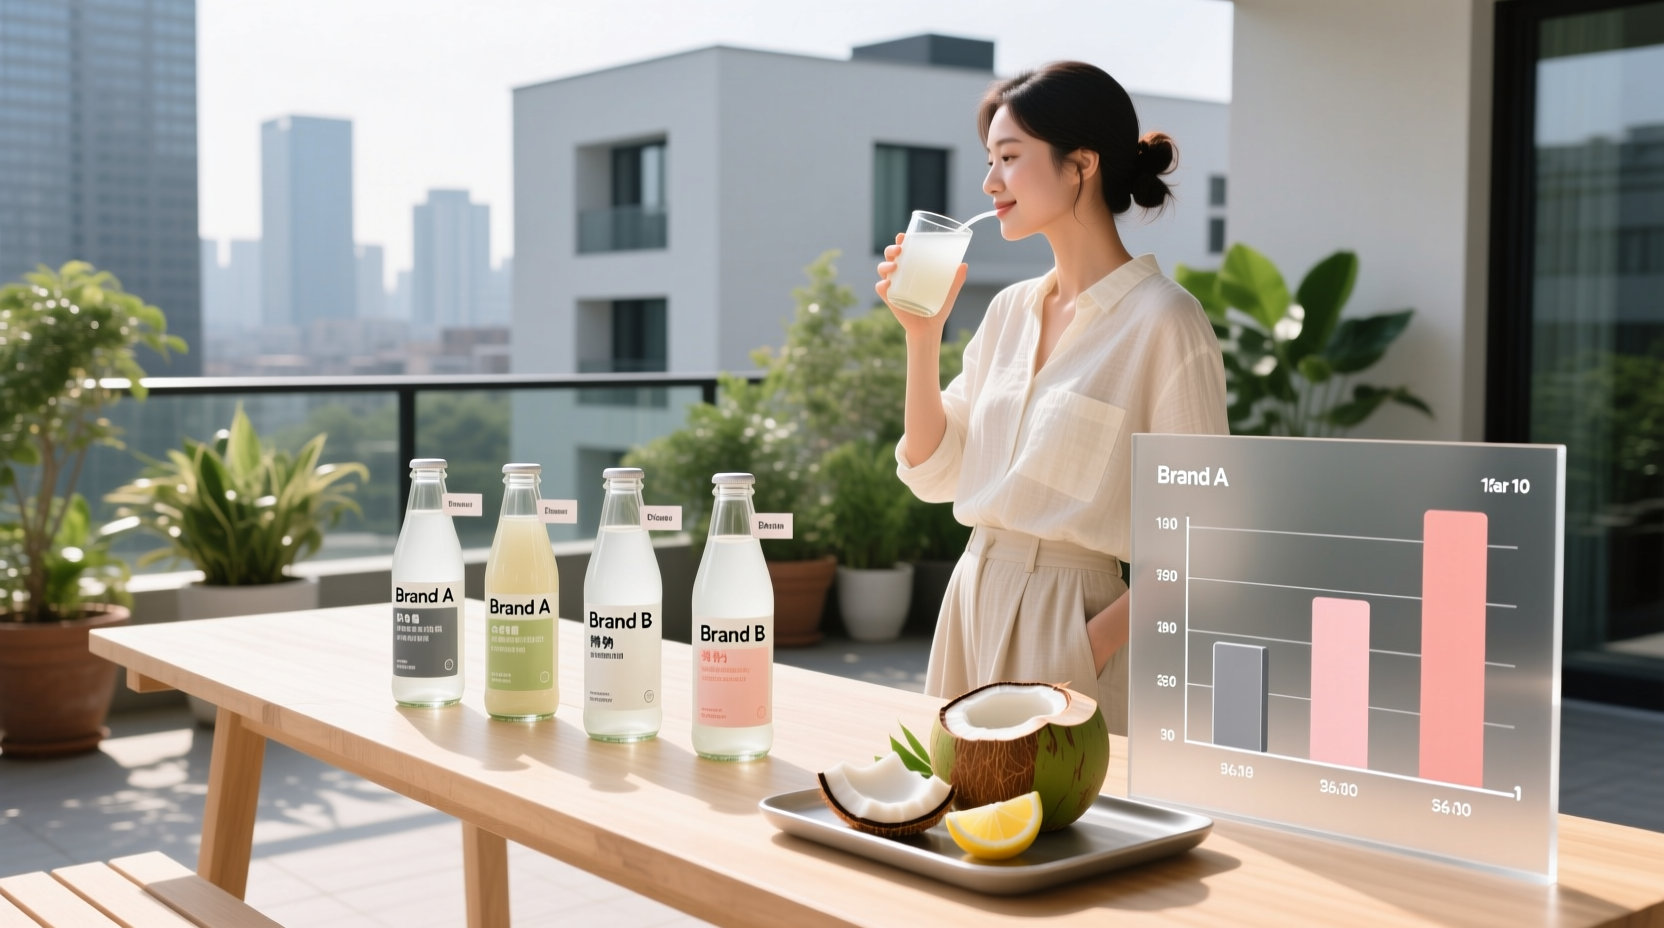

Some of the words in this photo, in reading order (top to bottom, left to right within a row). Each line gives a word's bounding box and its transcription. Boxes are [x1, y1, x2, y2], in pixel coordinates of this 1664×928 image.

[1157, 465, 1210, 486] Brand
[1213, 467, 1229, 487] A
[1511, 478, 1531, 494] 10
[395, 587, 438, 603] Brand
[442, 587, 454, 603] A
[490, 598, 534, 615] Brand
[538, 598, 551, 615] A
[589, 611, 636, 629] Brand
[641, 612, 652, 629] B
[700, 624, 749, 642] Brand
[754, 624, 765, 642] B
